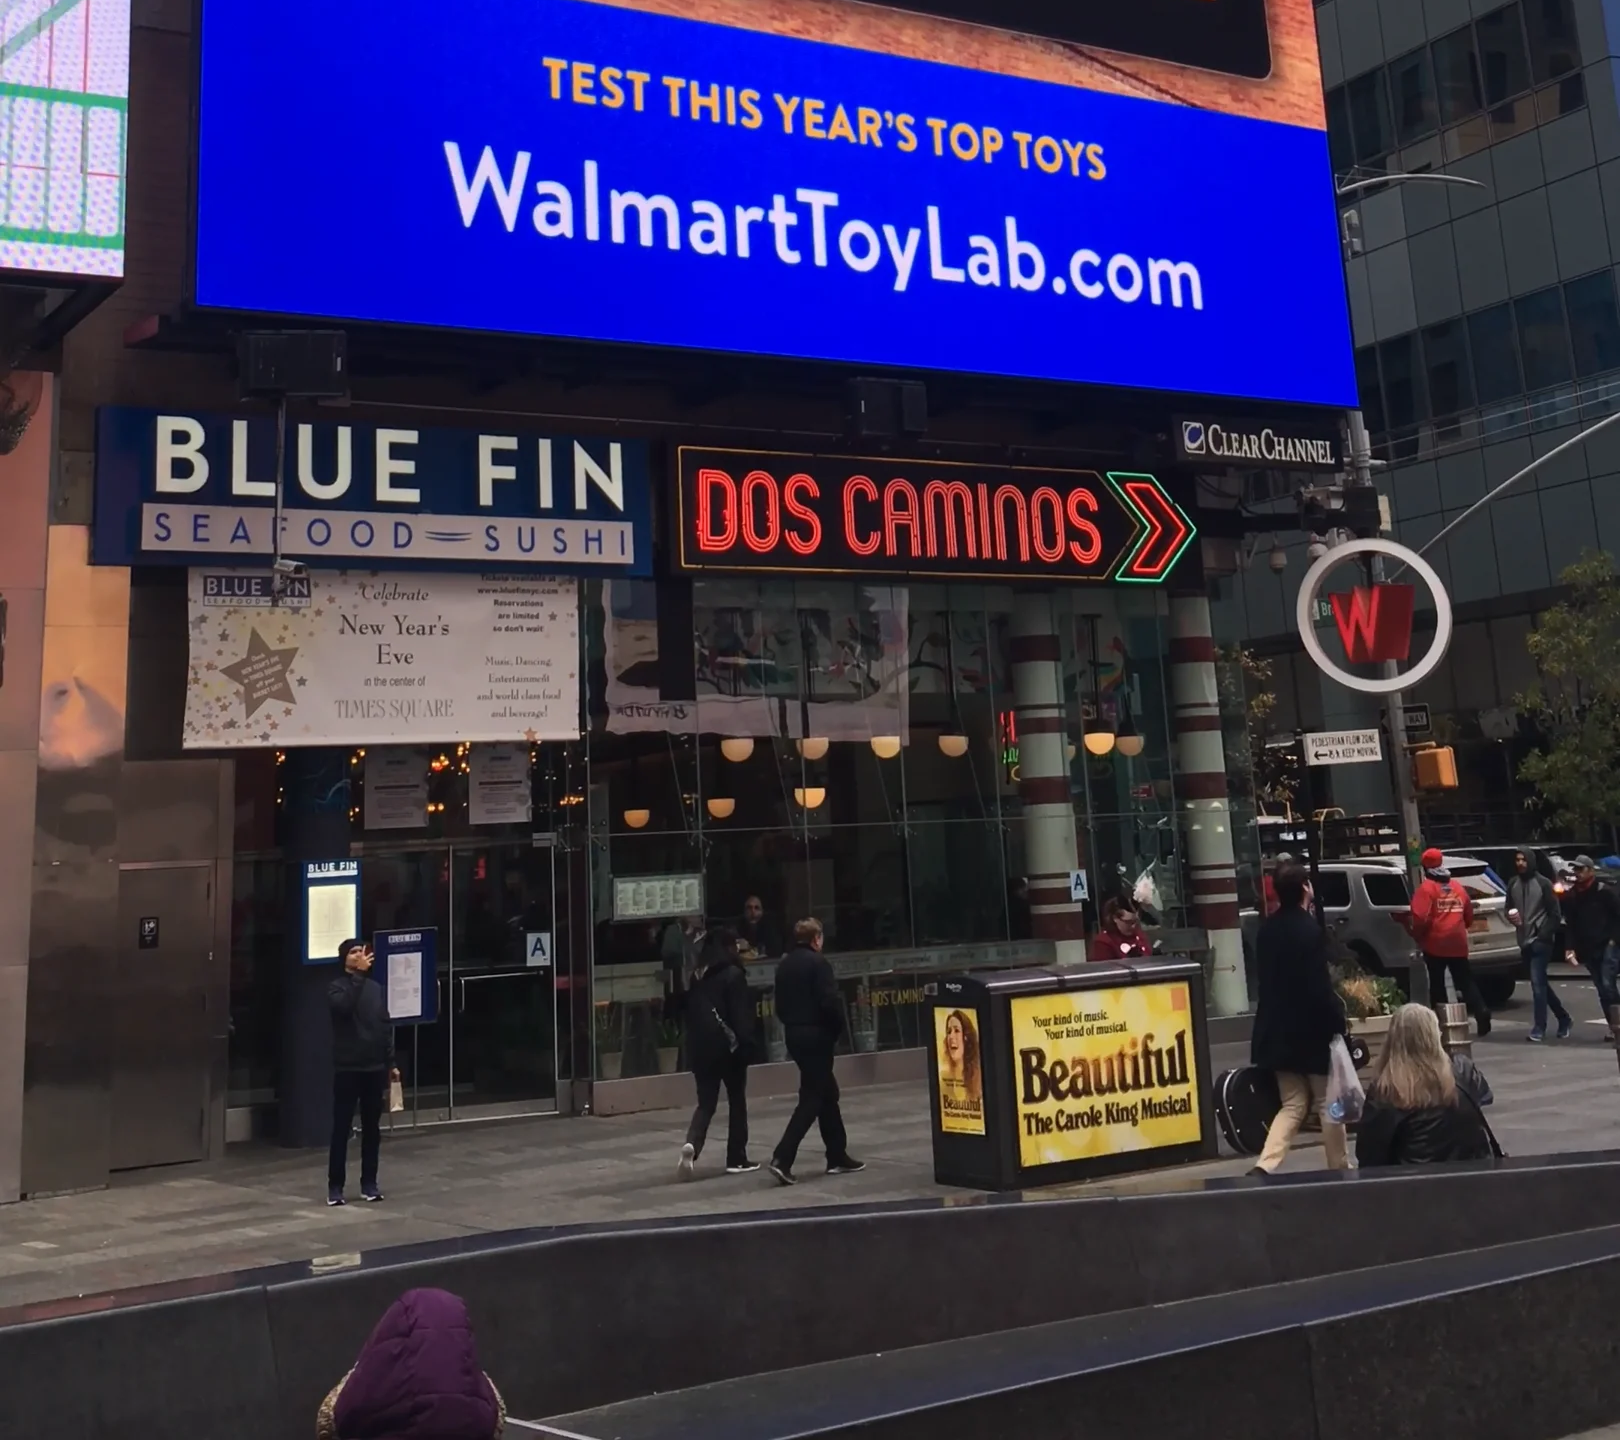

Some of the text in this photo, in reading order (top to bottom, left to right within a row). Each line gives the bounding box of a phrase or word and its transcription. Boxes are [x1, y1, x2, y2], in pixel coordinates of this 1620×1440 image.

[542, 57, 1107, 180] TEST THIS YEAR'S TOP TOYS
[442, 141, 1204, 311] WalmartToyLab.com
[155, 415, 625, 512] BLUE FIN
[698, 469, 1102, 564] DOS CAMINOS
[154, 512, 627, 556] SEAFOOD SUSHI
[207, 577, 262, 595] BLUE
[361, 582, 430, 601] Celebrate
[493, 599, 544, 607] Reservations
[339, 614, 450, 636] New Year's
[512, 612, 540, 620] limited
[1328, 585, 1390, 664] W
[376, 642, 414, 665] Eve
[364, 676, 426, 686] in the center of
[477, 689, 494, 700] and
[495, 689, 519, 700] world
[334, 699, 454, 723] TIMES SQUARE
[491, 706, 507, 718] and
[1408, 713, 1425, 724] WAY
[1311, 734, 1376, 747] PEDESTRIAN FLOW ZONE
[1342, 747, 1378, 758] KEEP MOVING
[308, 861, 358, 872] BLUE FIN
[1073, 873, 1085, 891] A
[530, 936, 546, 957] A
[891, 988, 925, 1005] CAMINO
[1032, 1015, 1052, 1028] Your
[1053, 1013, 1072, 1026] kind
[1073, 1011, 1083, 1023] of
[1044, 1027, 1064, 1040] Your
[1066, 1025, 1084, 1038] kind
[1085, 1023, 1095, 1036] of
[1018, 1028, 1190, 1106] Beautiful
[1023, 1091, 1193, 1137] The Carole King Musical
